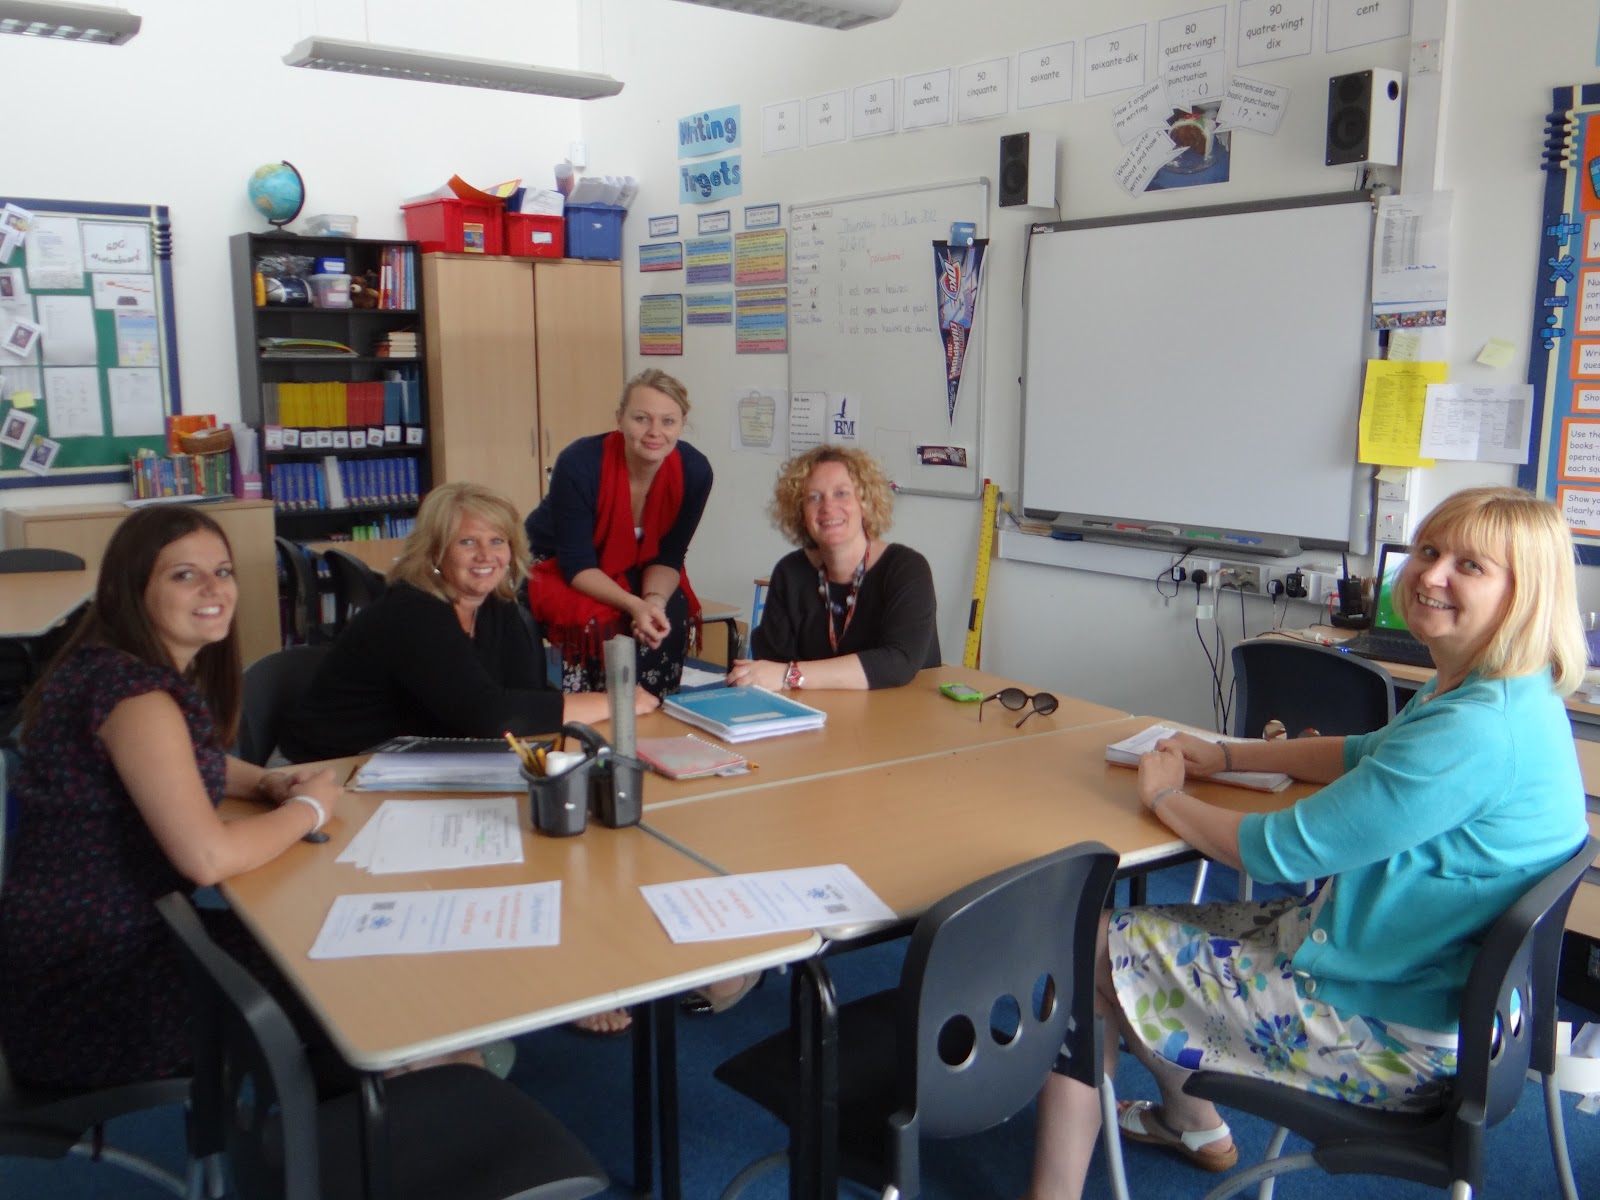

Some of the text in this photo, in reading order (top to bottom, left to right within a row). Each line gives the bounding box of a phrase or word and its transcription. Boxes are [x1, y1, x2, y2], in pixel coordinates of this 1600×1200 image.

[1269, 4, 1282, 17] 90
[1356, 3, 1380, 16] cent
[1184, 23, 1197, 35] 80
[1246, 16, 1304, 40] quatre-vingt
[1108, 40, 1120, 52] 70
[1164, 35, 1217, 57] quatre-vingt
[1266, 38, 1282, 50] dix
[1040, 56, 1050, 68] 60
[1090, 52, 1138, 72] soixante-dix
[1169, 58, 1202, 72] Advanced
[977, 71, 987, 82] 50
[1030, 70, 1060, 84] soixante
[1168, 70, 1208, 87] punctuation
[922, 82, 932, 91] 40
[967, 84, 998, 98] cinquante
[1231, 79, 1277, 97] Sentences and
[869, 93, 878, 102] 30
[912, 95, 940, 107] quarante
[1113, 106, 1128, 118] How
[1133, 83, 1160, 107] organise
[1226, 90, 1280, 111] basic punctuation
[778, 111, 785, 119] 10
[679, 113, 737, 146] Writing
[1116, 120, 1125, 129] my
[1115, 157, 1131, 177] What
[1135, 132, 1149, 152] write
[1122, 165, 1138, 185] about
[1136, 151, 1147, 166] and
[1145, 138, 1158, 154] how
[1129, 173, 1143, 192] write
[944, 261, 957, 292] OKC
[948, 321, 960, 380] CHAMPIONS
[1584, 393, 1600, 402] Sho
[833, 419, 856, 436] BM
[1570, 430, 1586, 438] Use
[1569, 441, 1593, 450] books
[1567, 465, 1587, 473] each
[1567, 494, 1590, 503] Show
[1566, 506, 1594, 517] clearly
